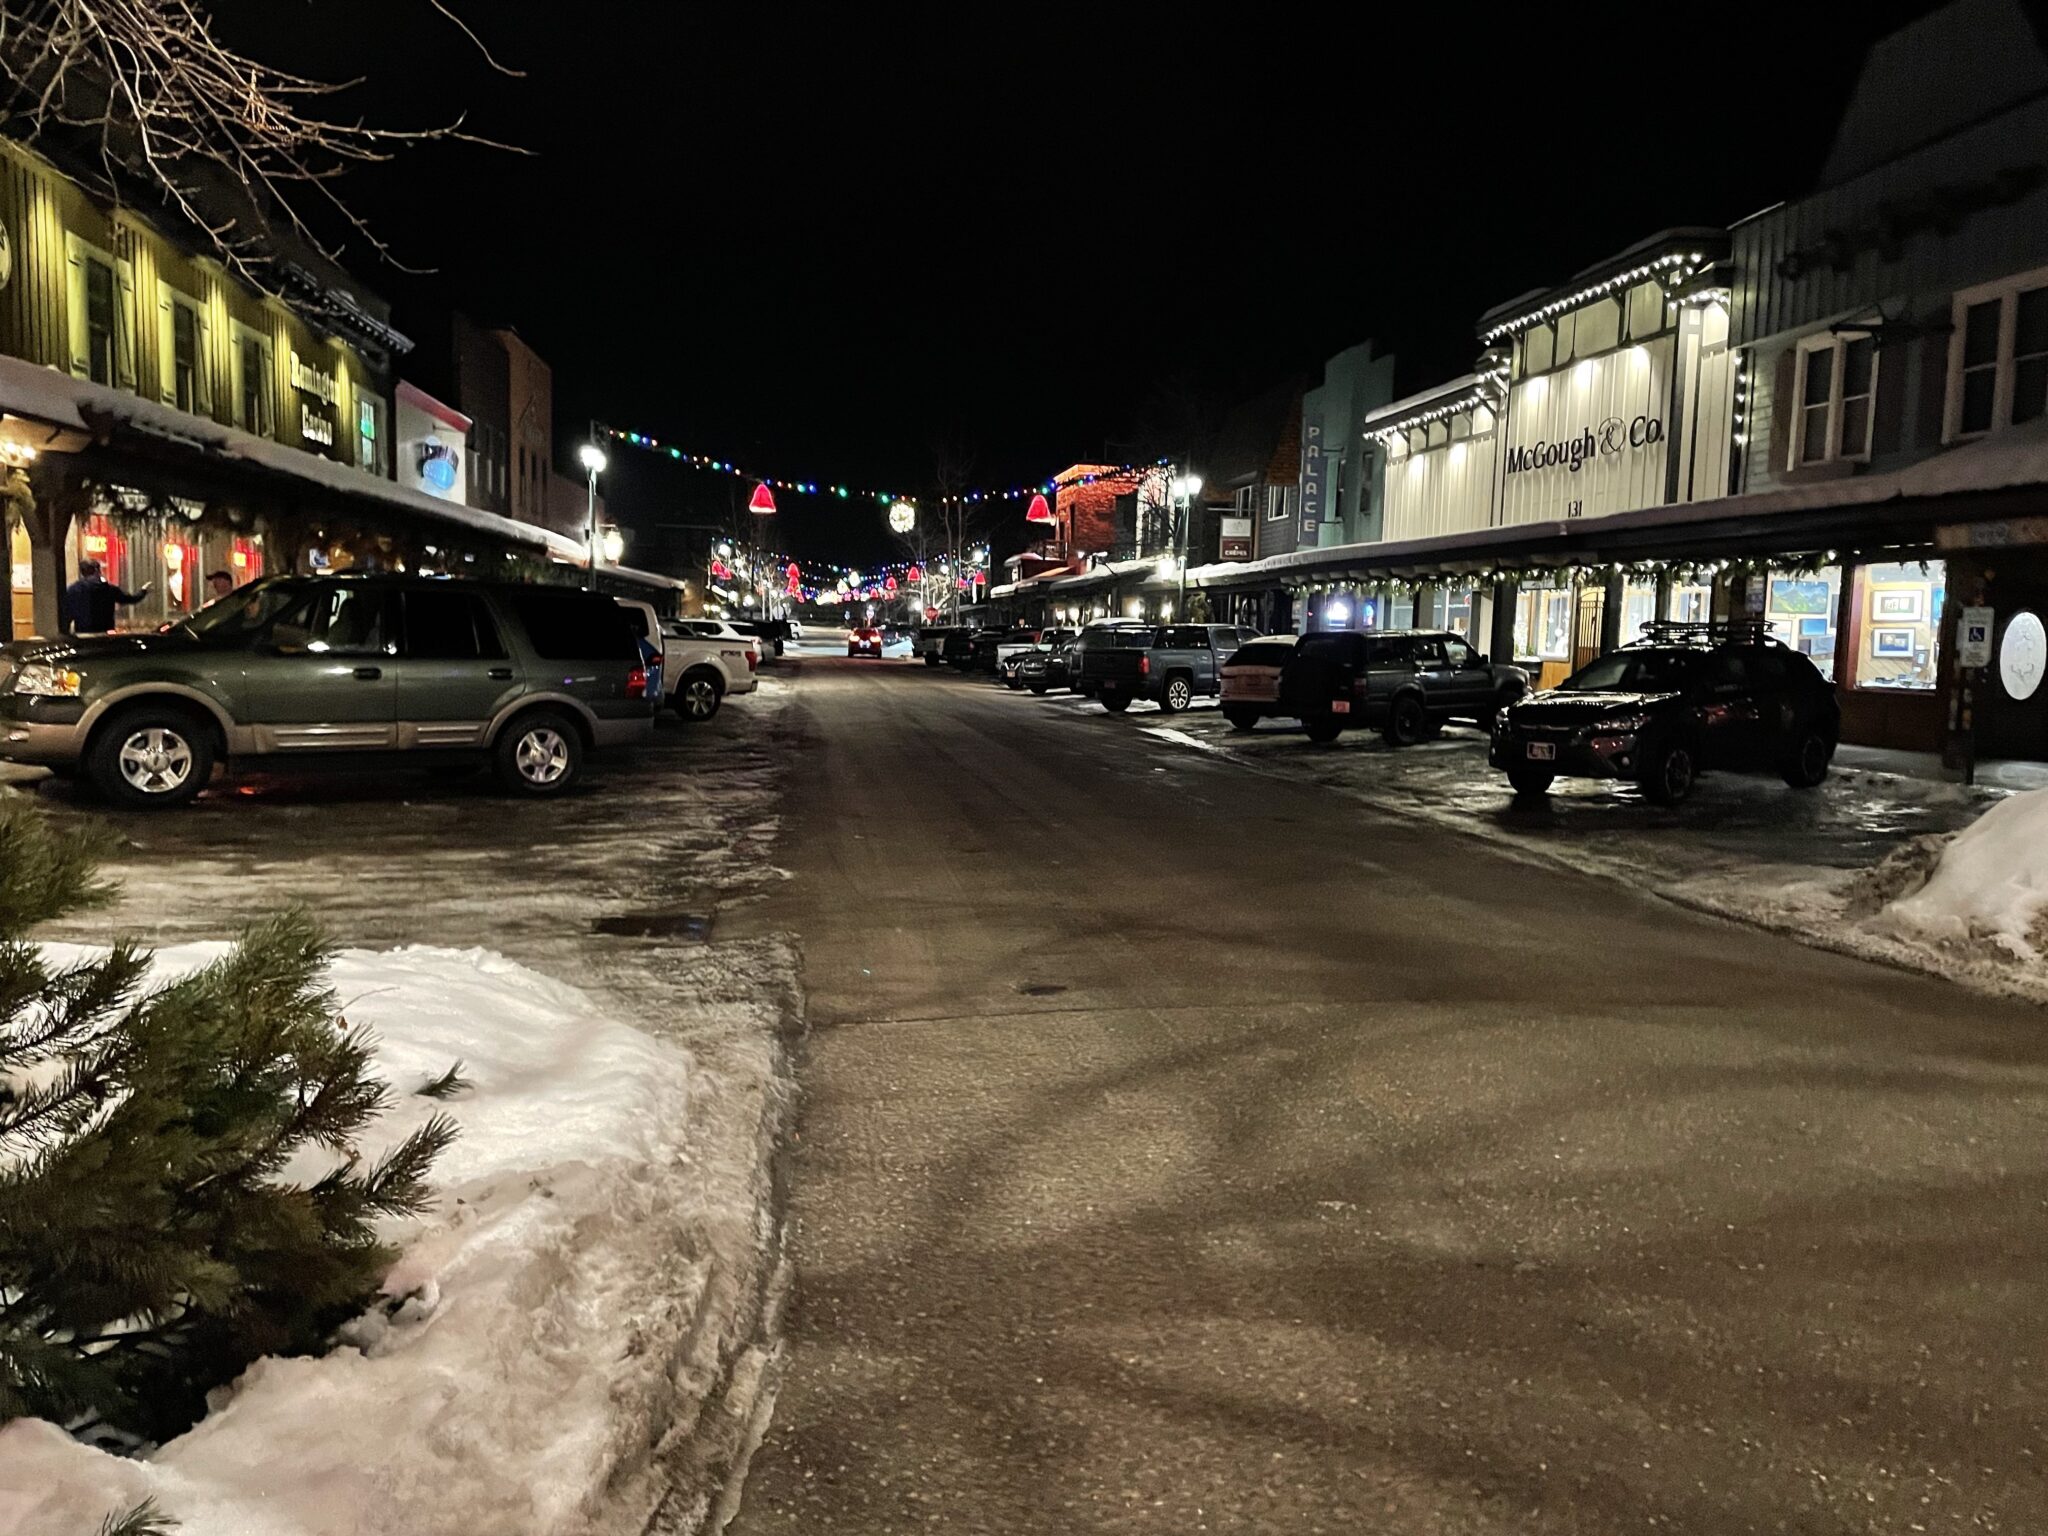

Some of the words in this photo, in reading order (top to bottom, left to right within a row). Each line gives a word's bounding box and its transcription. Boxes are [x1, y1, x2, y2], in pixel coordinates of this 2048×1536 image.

[302, 403, 332, 447] Casino
[1507, 427, 1596, 473] McGough
[1598, 416, 1627, 456] &
[1629, 415, 1665, 448] Co.
[1303, 426, 1320, 532] PALACE
[1567, 500, 1583, 518] 131
